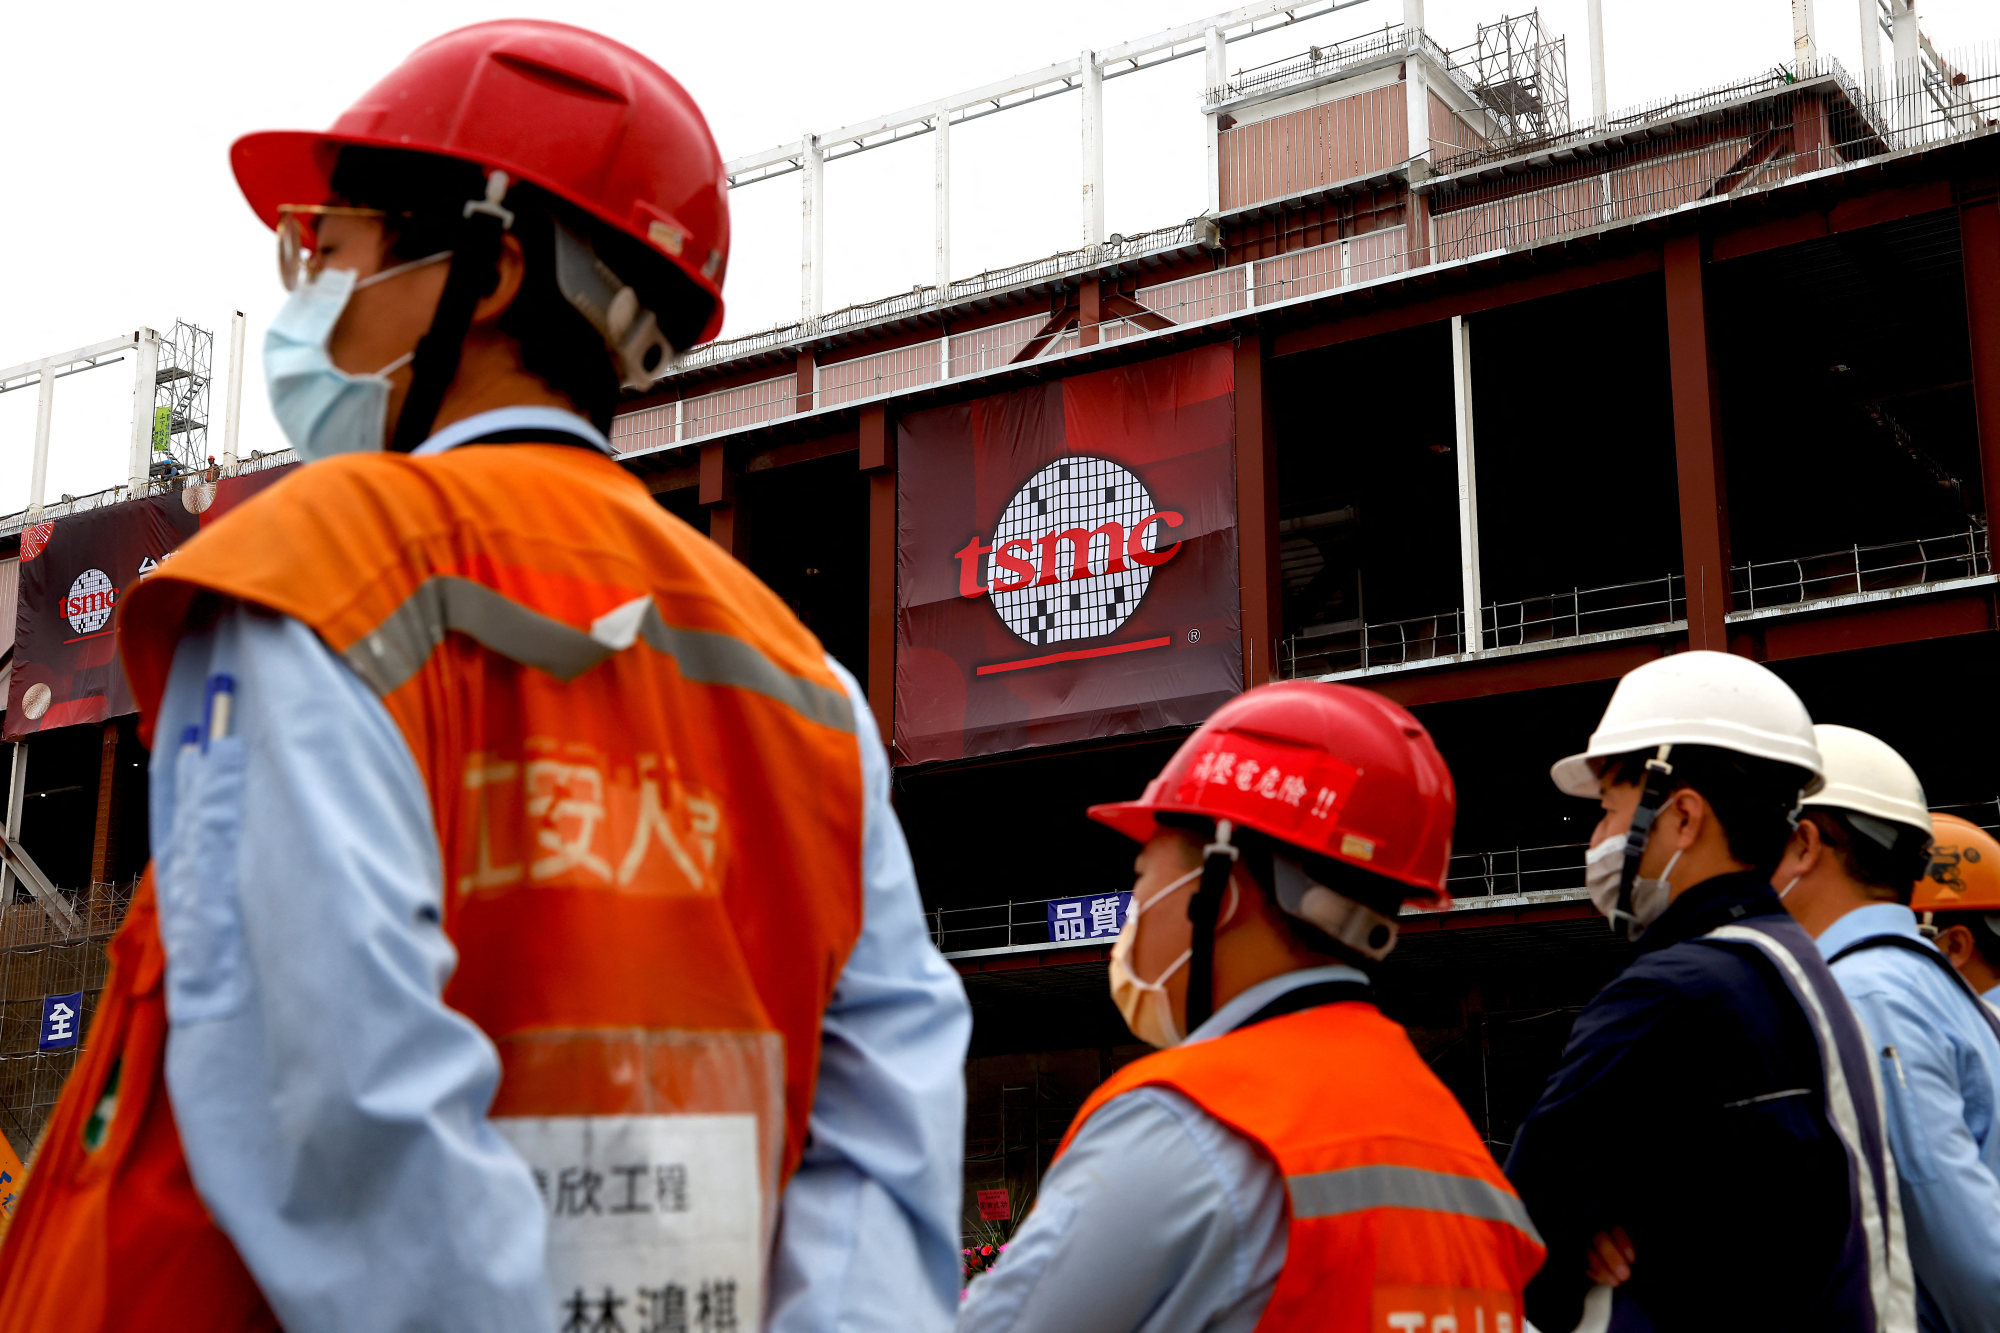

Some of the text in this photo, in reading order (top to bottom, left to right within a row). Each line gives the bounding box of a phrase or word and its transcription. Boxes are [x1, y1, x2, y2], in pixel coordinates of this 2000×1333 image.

[954, 510, 1185, 599] tsmc
[57, 588, 121, 619] tsmc
[1053, 895, 1138, 942] 品質
[47, 1002, 75, 1041] 全
[533, 1162, 690, 1217] 欣工程
